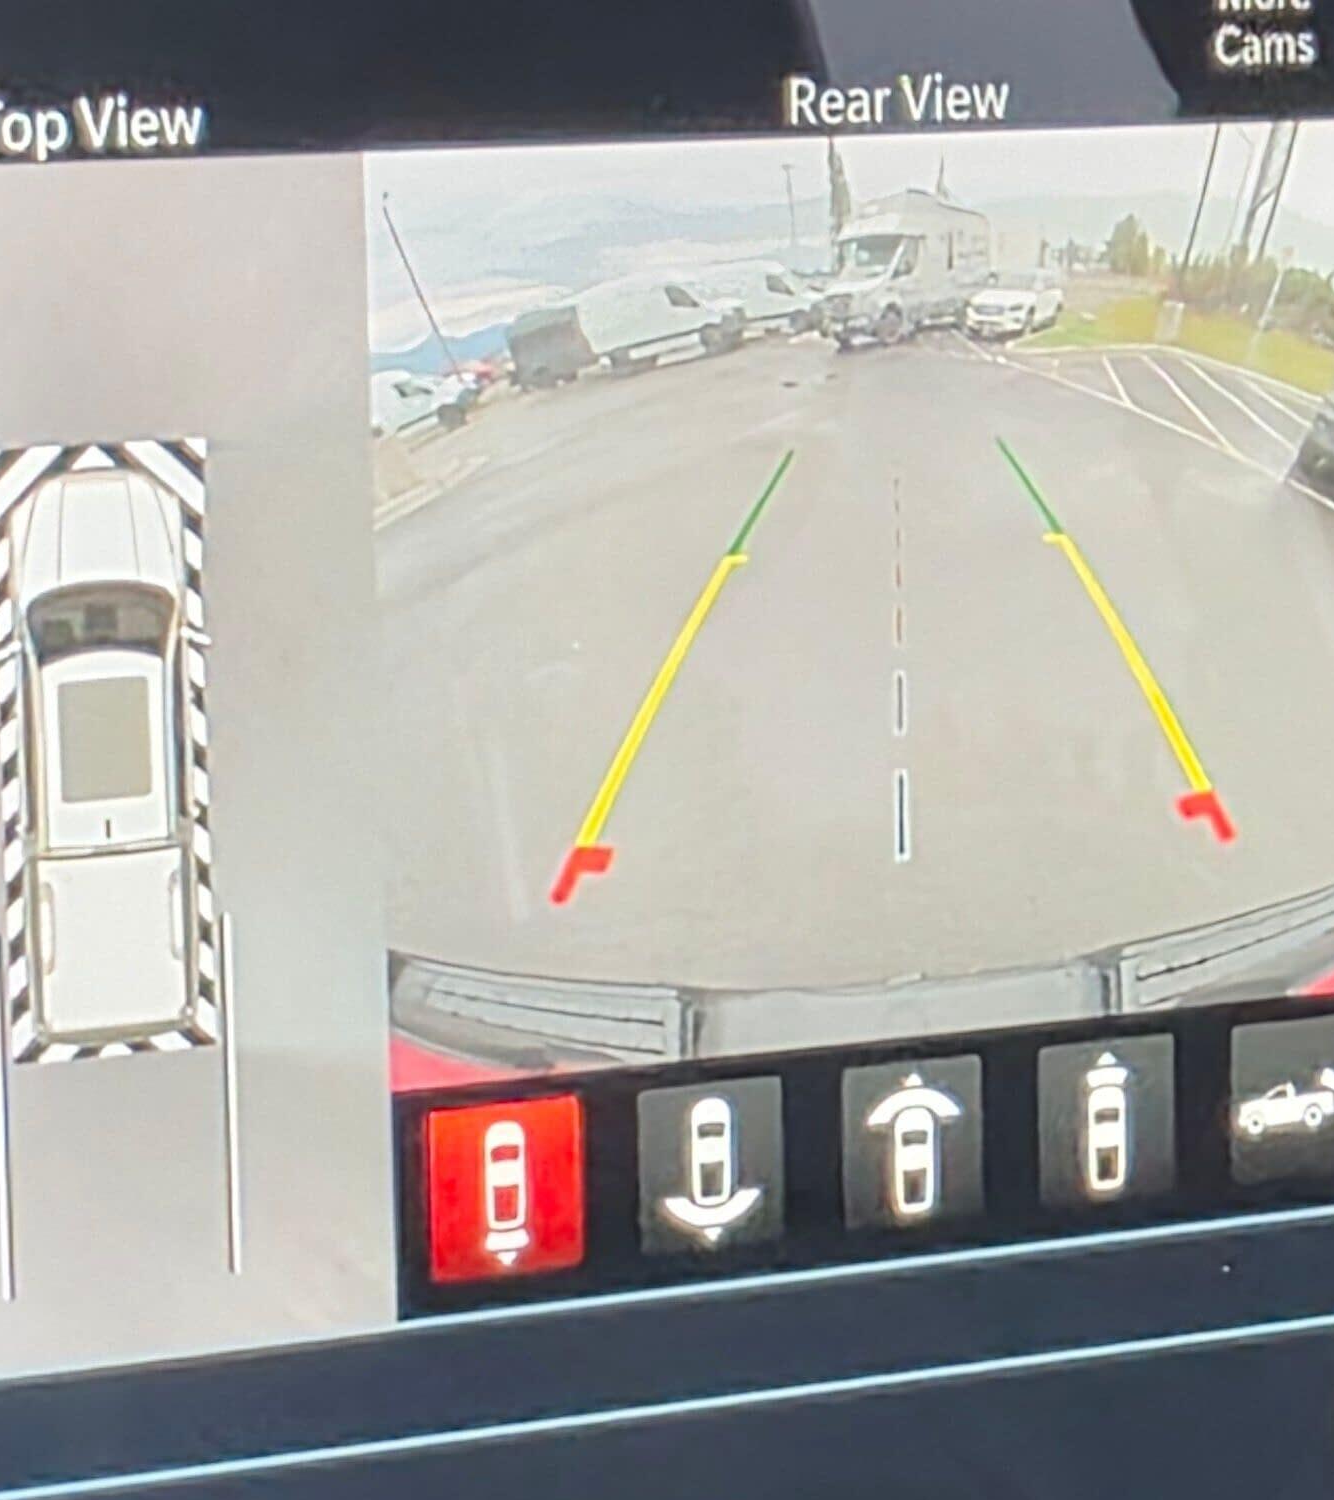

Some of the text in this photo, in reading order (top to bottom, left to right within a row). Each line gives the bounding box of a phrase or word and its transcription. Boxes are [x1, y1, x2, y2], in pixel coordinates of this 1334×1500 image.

[1216, 23, 1318, 67] Cams
[77, 93, 204, 148] View
[788, 72, 1010, 126] Rear View
